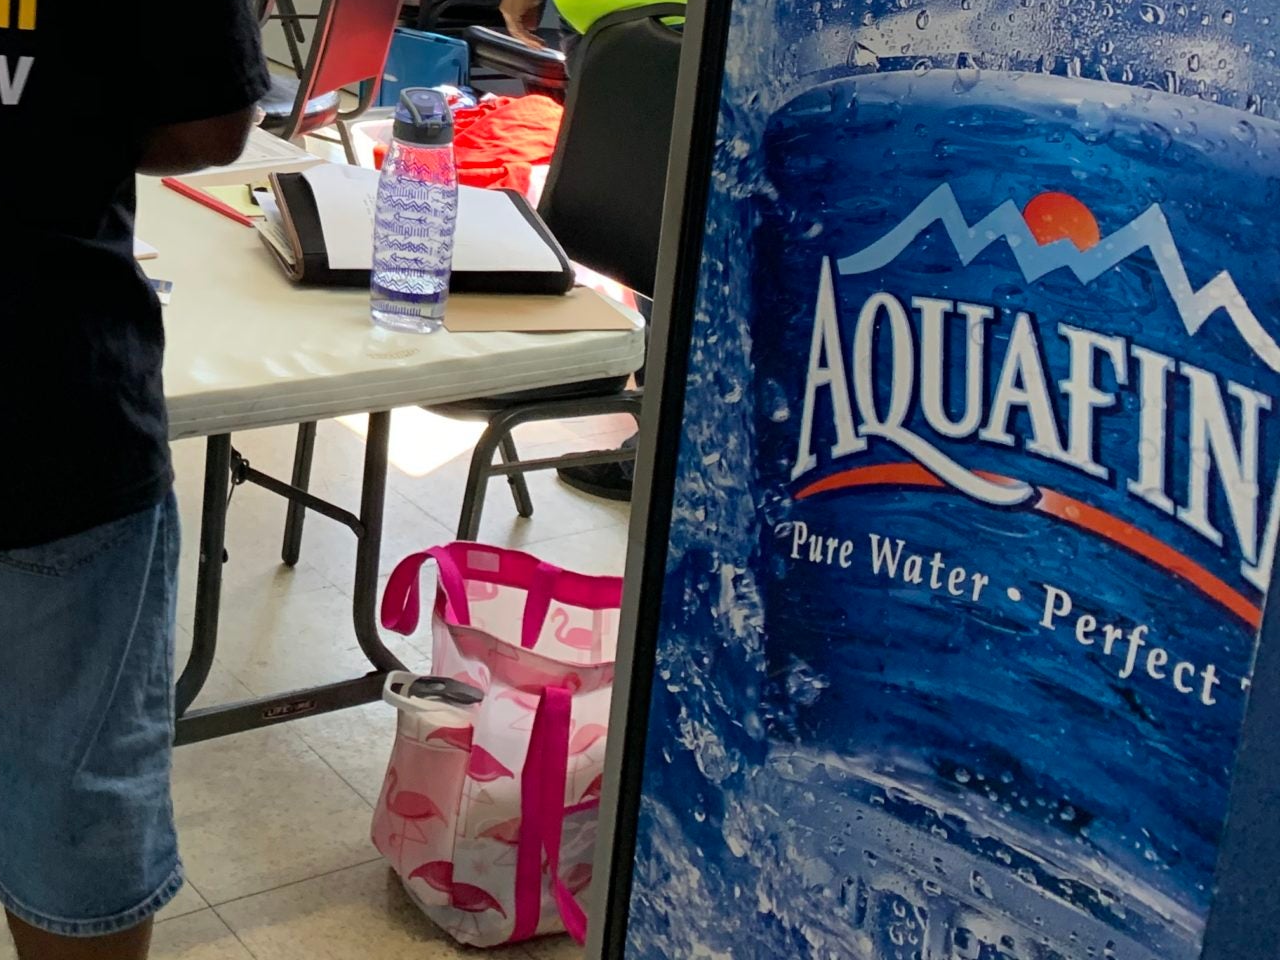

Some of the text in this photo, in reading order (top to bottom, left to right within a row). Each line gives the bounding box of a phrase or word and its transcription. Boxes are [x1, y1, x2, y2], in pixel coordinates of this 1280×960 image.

[791, 521, 1220, 706] Pure Water Perfect
